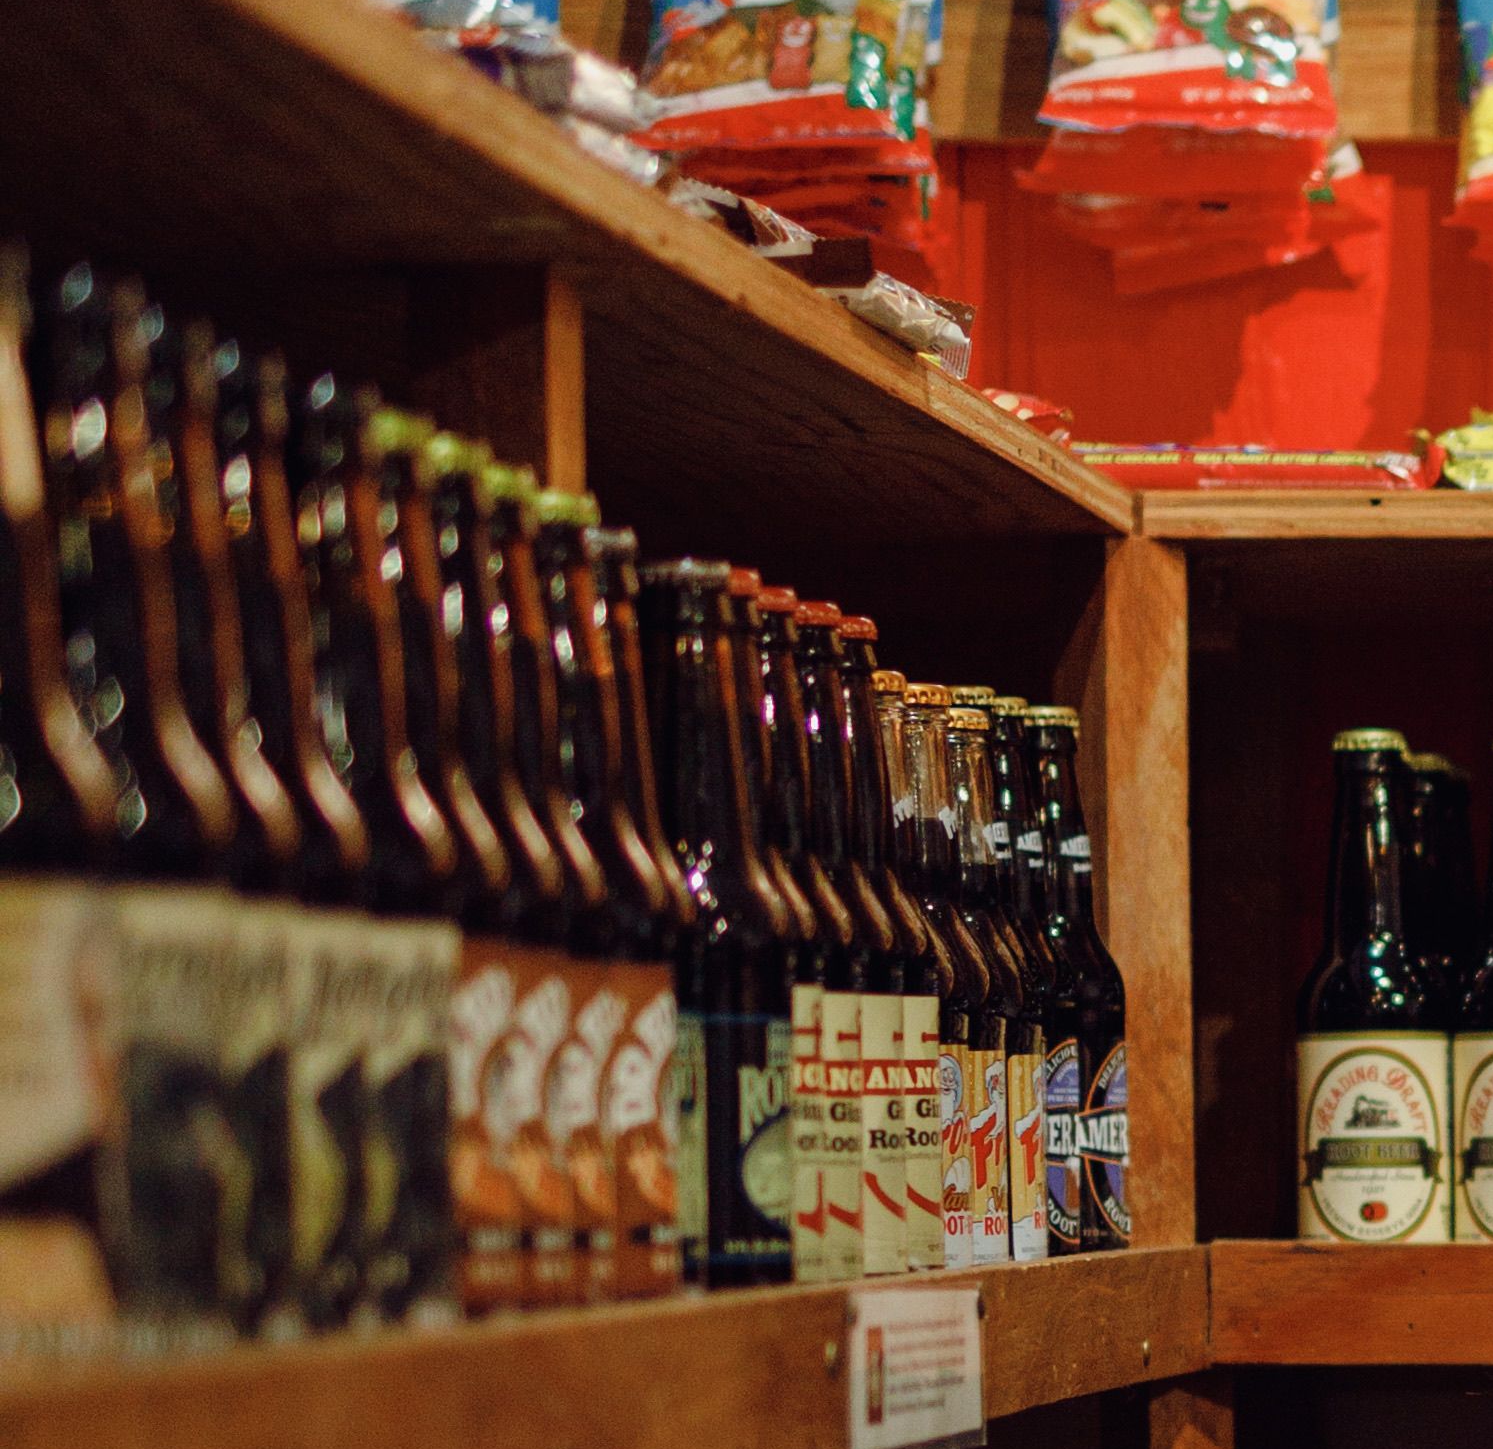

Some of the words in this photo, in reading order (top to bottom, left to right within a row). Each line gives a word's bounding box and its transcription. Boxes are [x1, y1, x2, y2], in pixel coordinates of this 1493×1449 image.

[1314, 1064, 1380, 1136] READING
[1384, 1067, 1429, 1134] DRAFT
[1327, 1142, 1373, 1160] ROOT
[1377, 1142, 1422, 1160] BEER
